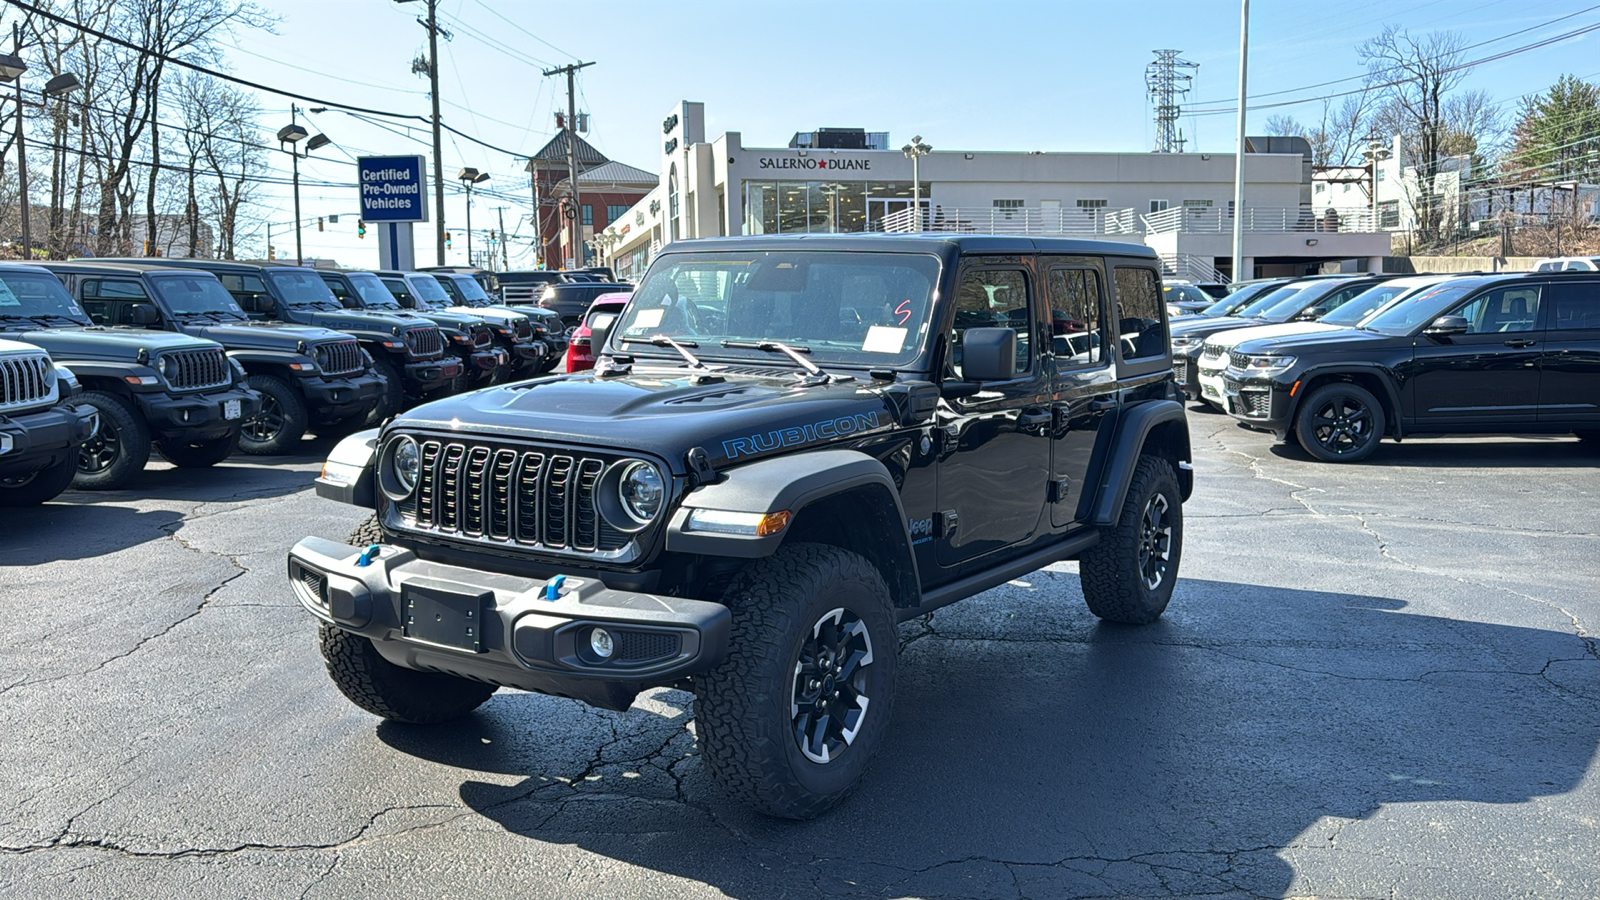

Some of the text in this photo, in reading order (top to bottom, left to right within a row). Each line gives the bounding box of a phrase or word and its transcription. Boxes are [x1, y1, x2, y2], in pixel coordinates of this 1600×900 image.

[759, 157, 871, 170] SALERNO DUANE
[362, 168, 410, 181] Certified
[363, 182, 418, 195] Pre-Owned
[364, 197, 412, 209] Vehicles
[722, 411, 880, 459] RUBICON
[908, 517, 933, 536] Jeep
